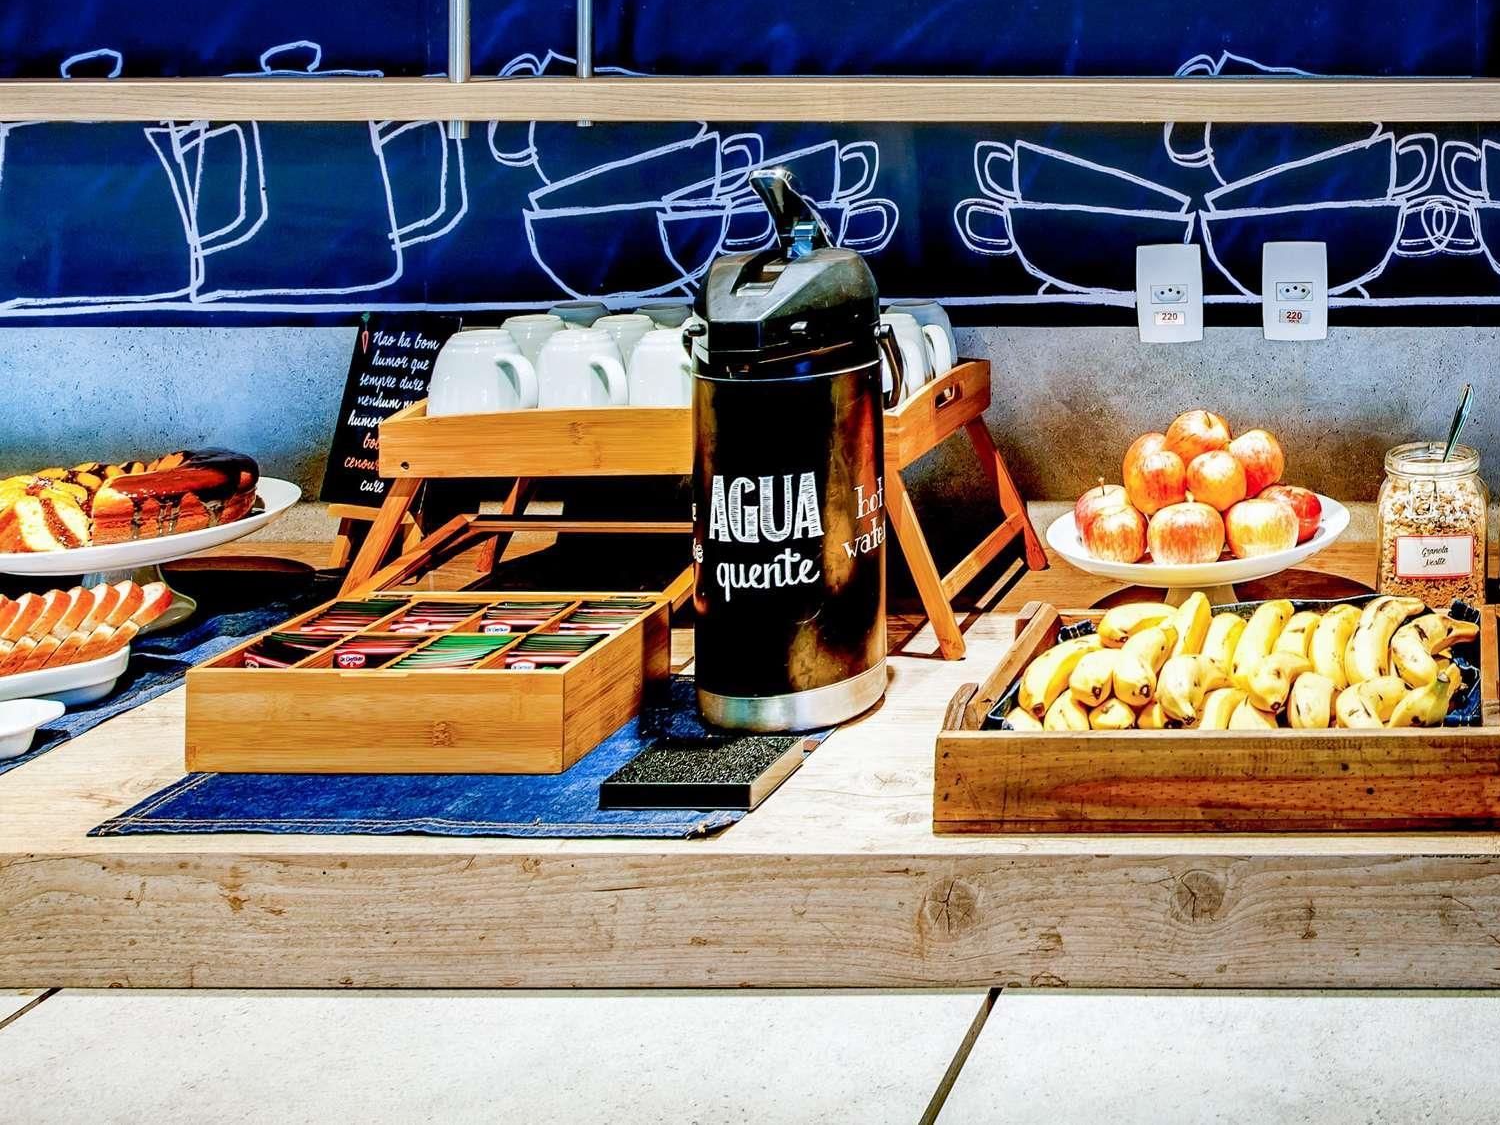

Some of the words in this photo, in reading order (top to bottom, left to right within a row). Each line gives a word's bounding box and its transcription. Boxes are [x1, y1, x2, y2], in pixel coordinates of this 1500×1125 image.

[1162, 312, 1178, 321] 220
[1286, 311, 1302, 320] 220
[414, 333, 440, 350] bom
[371, 350, 409, 368] humor
[410, 358, 430, 375] que
[359, 373, 397, 393] sempre
[399, 376, 424, 391] dure
[357, 391, 402, 410] nenhum
[359, 479, 385, 493] cure
[708, 471, 825, 544] AGUA
[1421, 545, 1449, 558] Granola
[716, 547, 820, 603] quente
